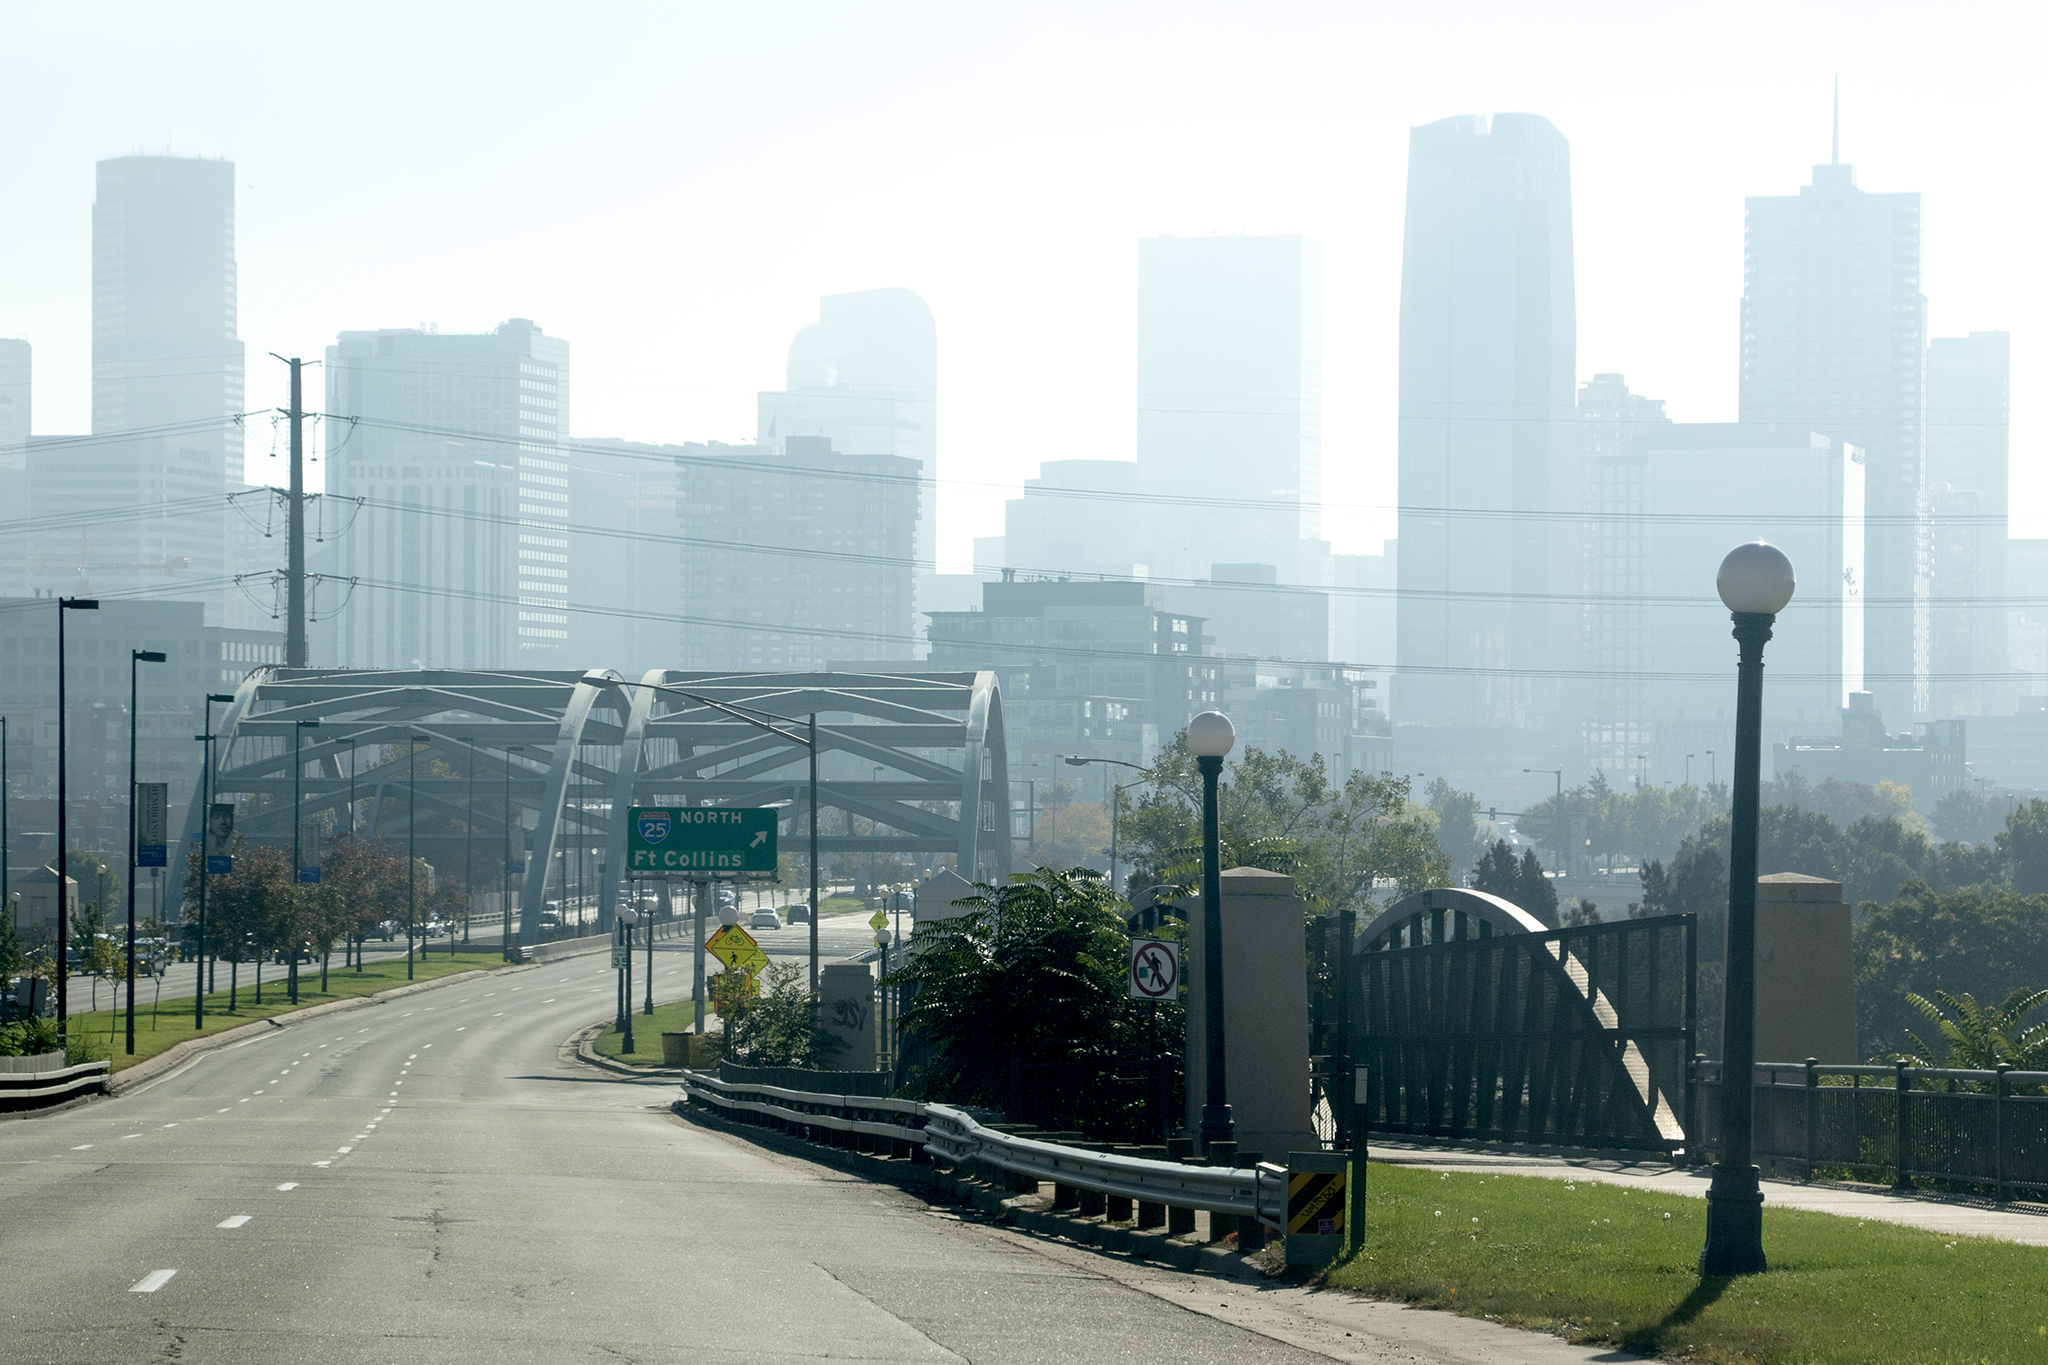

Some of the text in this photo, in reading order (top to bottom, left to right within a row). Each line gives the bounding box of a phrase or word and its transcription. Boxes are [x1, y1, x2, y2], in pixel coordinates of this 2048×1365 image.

[150, 785, 159, 842] REMBRANDT
[680, 811, 742, 825] NORTH
[644, 822, 667, 838] 25
[634, 850, 742, 867] Ft Collins
[613, 957, 628, 967] 35
